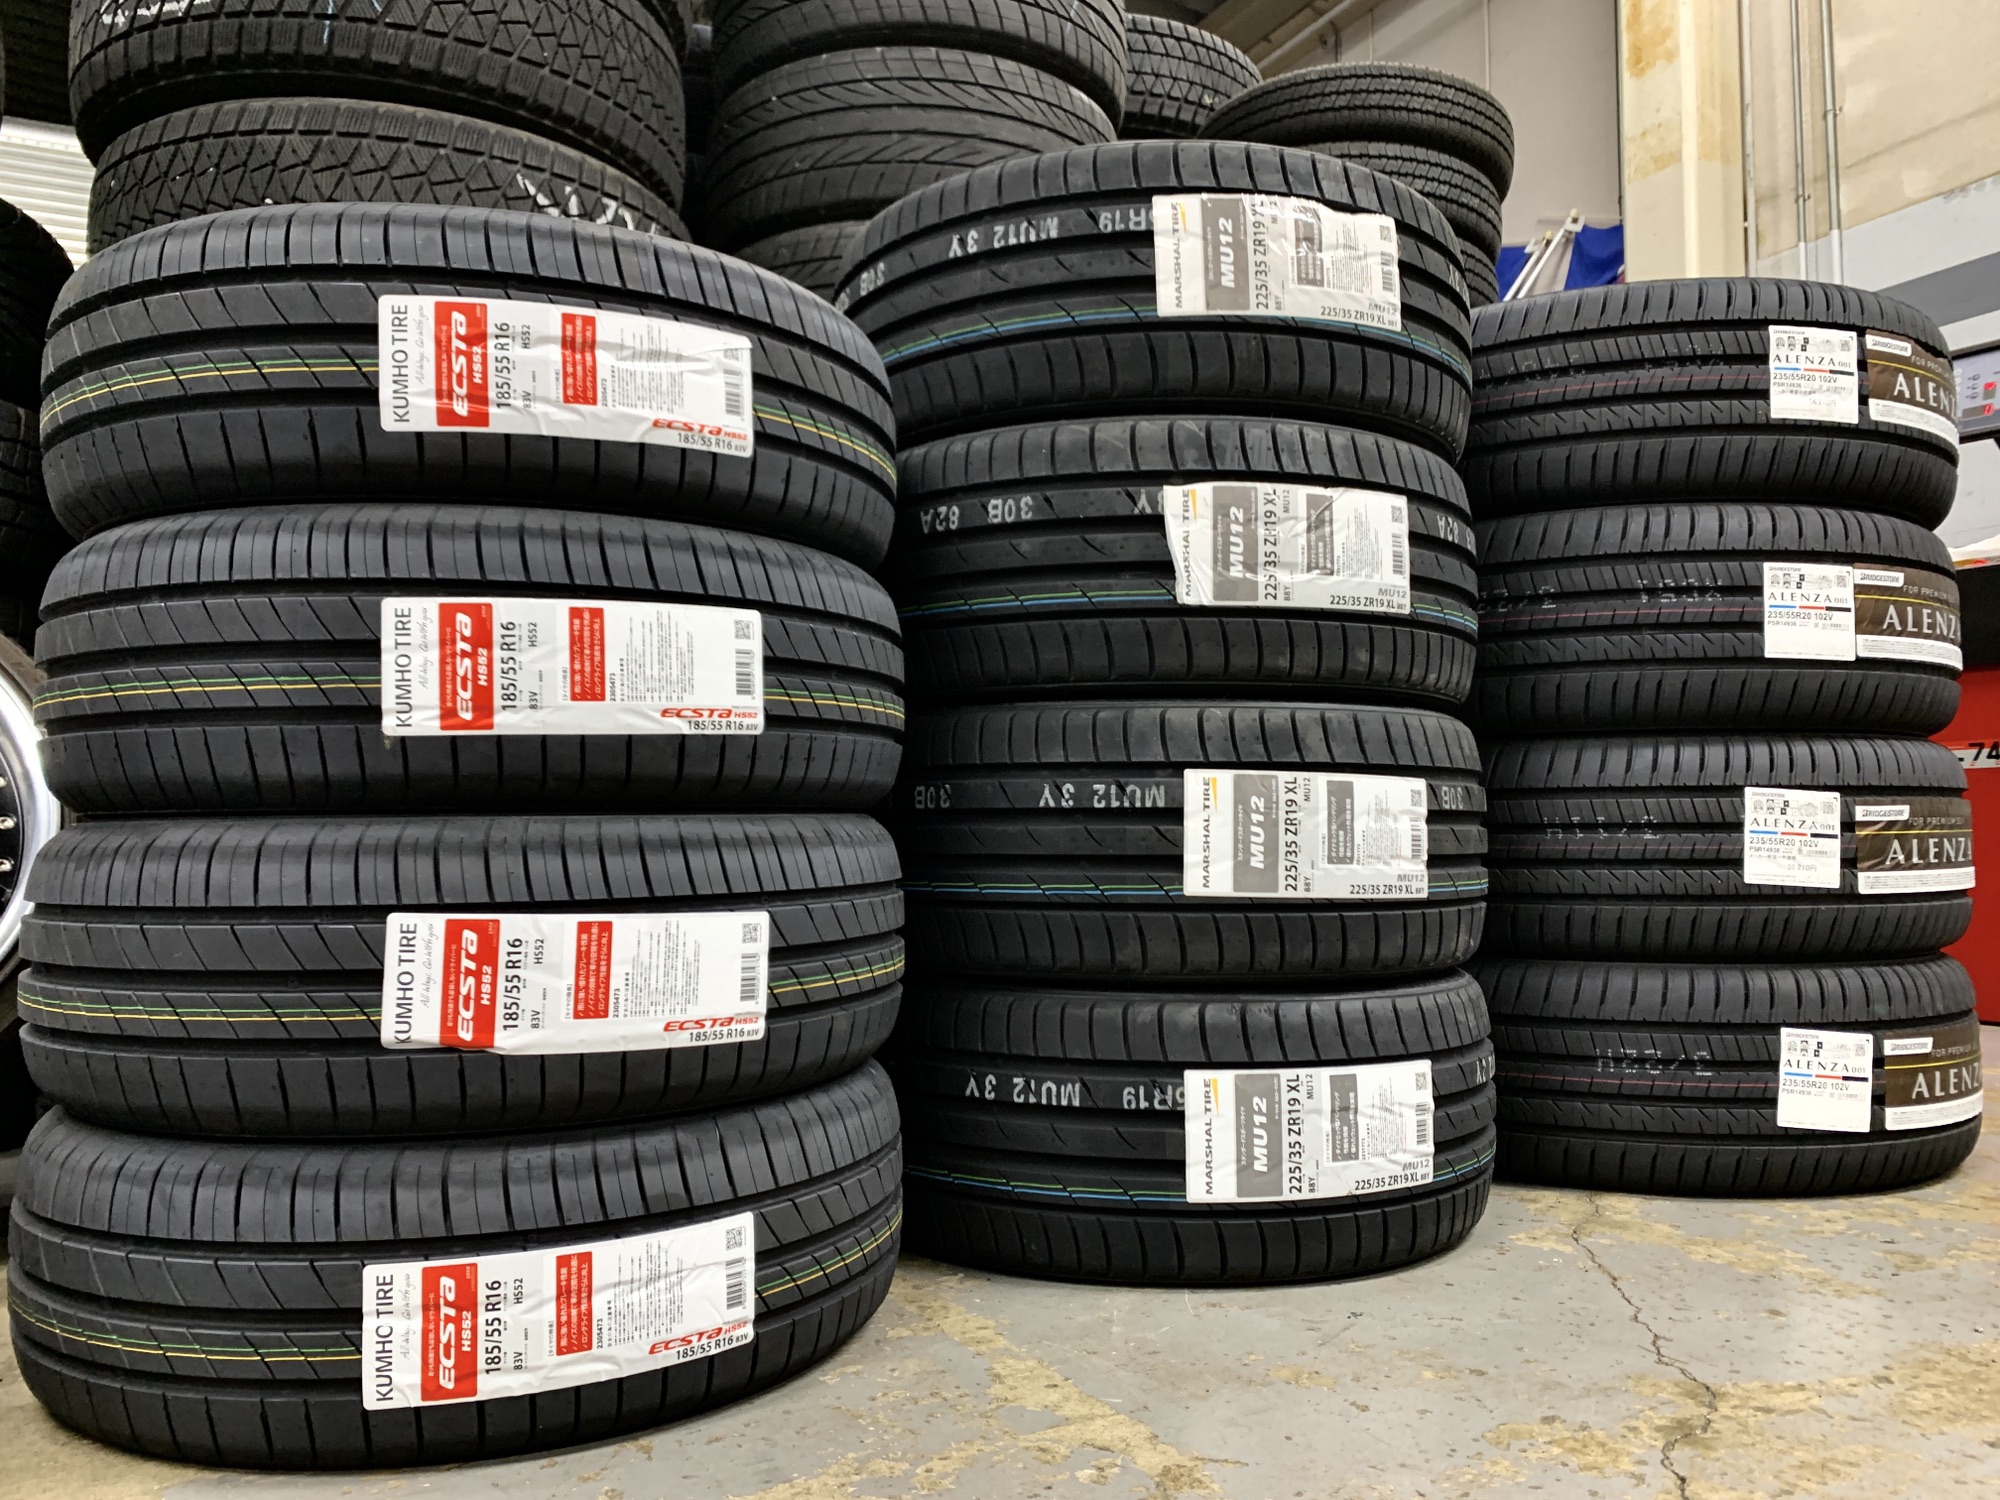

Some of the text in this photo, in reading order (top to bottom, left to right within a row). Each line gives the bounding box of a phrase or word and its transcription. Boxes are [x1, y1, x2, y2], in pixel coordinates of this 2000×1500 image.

[993, 216, 1059, 249] MU12
[1100, 207, 1153, 233] R19
[948, 230, 979, 258] 3Y
[1218, 217, 1236, 289] MU12
[1173, 238, 1183, 309] MARSHAL
[1253, 221, 1269, 310] 225/35 ZR19
[1320, 306, 1387, 326] 225/35 ZR19 XL
[521, 324, 531, 349] HS52
[391, 304, 411, 424] KUMHO TIRE
[472, 346, 484, 383] HS52
[494, 321, 514, 409] 185/55 R16
[1773, 354, 1836, 367] ALENZA
[1773, 372, 1838, 384] 235/55R20 102V
[522, 391, 533, 410] 83V
[677, 433, 733, 451] 185/55 R16
[724, 431, 748, 441] HS52
[1182, 489, 1191, 522] TIRE
[1263, 488, 1278, 507] XL
[1282, 489, 1290, 514] MU12
[920, 496, 1033, 534] 30B 82A
[1437, 514, 1459, 544] 82A
[1229, 506, 1245, 579] MU12
[1263, 550, 1278, 601] 225/35
[1860, 572, 1901, 584] BRIDGESTONE
[1283, 584, 1291, 602] 88Y
[1329, 594, 1396, 610] 225/35 ZR19 XL
[1378, 587, 1407, 599] MU12
[1768, 592, 1832, 604] ALENZA
[1903, 584, 1919, 594] FOR
[1767, 610, 1834, 621] 235/55R20 102V
[1882, 604, 1960, 640] ALENZ
[527, 621, 538, 648] HS52
[394, 607, 413, 728] KUMHO TIRE
[477, 646, 488, 687] HS52
[500, 621, 519, 711] 185/55 R16
[528, 690, 539, 710] 83V
[687, 719, 759, 731] 185/55 R16 83V
[1038, 783, 1075, 808] 3Y
[1092, 783, 1166, 808] MU12
[1303, 777, 1311, 803] MU12
[1441, 785, 1464, 810] 30B
[1750, 817, 1836, 831] ALENZA 001
[1861, 808, 1906, 818] BRIDGESTONE
[1908, 817, 1924, 826] FOR
[1202, 777, 1211, 889] MARSHAL TIRE
[1249, 795, 1265, 870] MU12
[1284, 776, 1298, 892] 225/35 ZR19 XL
[1749, 836, 1819, 848] 235/55R20 102V
[1349, 883, 1414, 896] 225/35 ZR19 XL
[1396, 873, 1425, 883] MU12
[534, 938, 545, 965] HS52
[394, 922, 418, 1045] KUMHO TIRE
[480, 964, 493, 1006] HS52
[502, 937, 523, 1032] 185/55 R16
[613, 987, 621, 1019] 2305473
[530, 1009, 542, 1030] 83V
[735, 1016, 759, 1026] HS52
[689, 1027, 760, 1043] 185/55 R16 83V
[1784, 1058, 1866, 1074] ALENZA 001
[965, 1072, 1081, 1108] MU12 3Y
[1305, 1073, 1314, 1100] MU12
[1782, 1078, 1850, 1091] 235/55R20 102V
[1203, 1078, 1213, 1195] MARSHAL TIRE
[1252, 1096, 1268, 1173] MU12
[1286, 1073, 1303, 1194] 225/35 ZR19 XL
[1402, 1159, 1431, 1171] MU12
[1308, 1176, 1317, 1194] 88Y
[1354, 1177, 1386, 1191] 225/35
[1387, 1174, 1409, 1188] ZR19
[1409, 1173, 1420, 1184] XL
[513, 1277, 524, 1305] HS52
[375, 1274, 394, 1402] KUMHO TIRE
[460, 1310, 472, 1353] HS52
[484, 1280, 503, 1375] 185/55 R16
[596, 1317, 604, 1349] 2305473
[724, 1320, 748, 1335] HS52
[675, 1332, 749, 1361] 185/55 R16 83V
[513, 1351, 523, 1371] 83V
